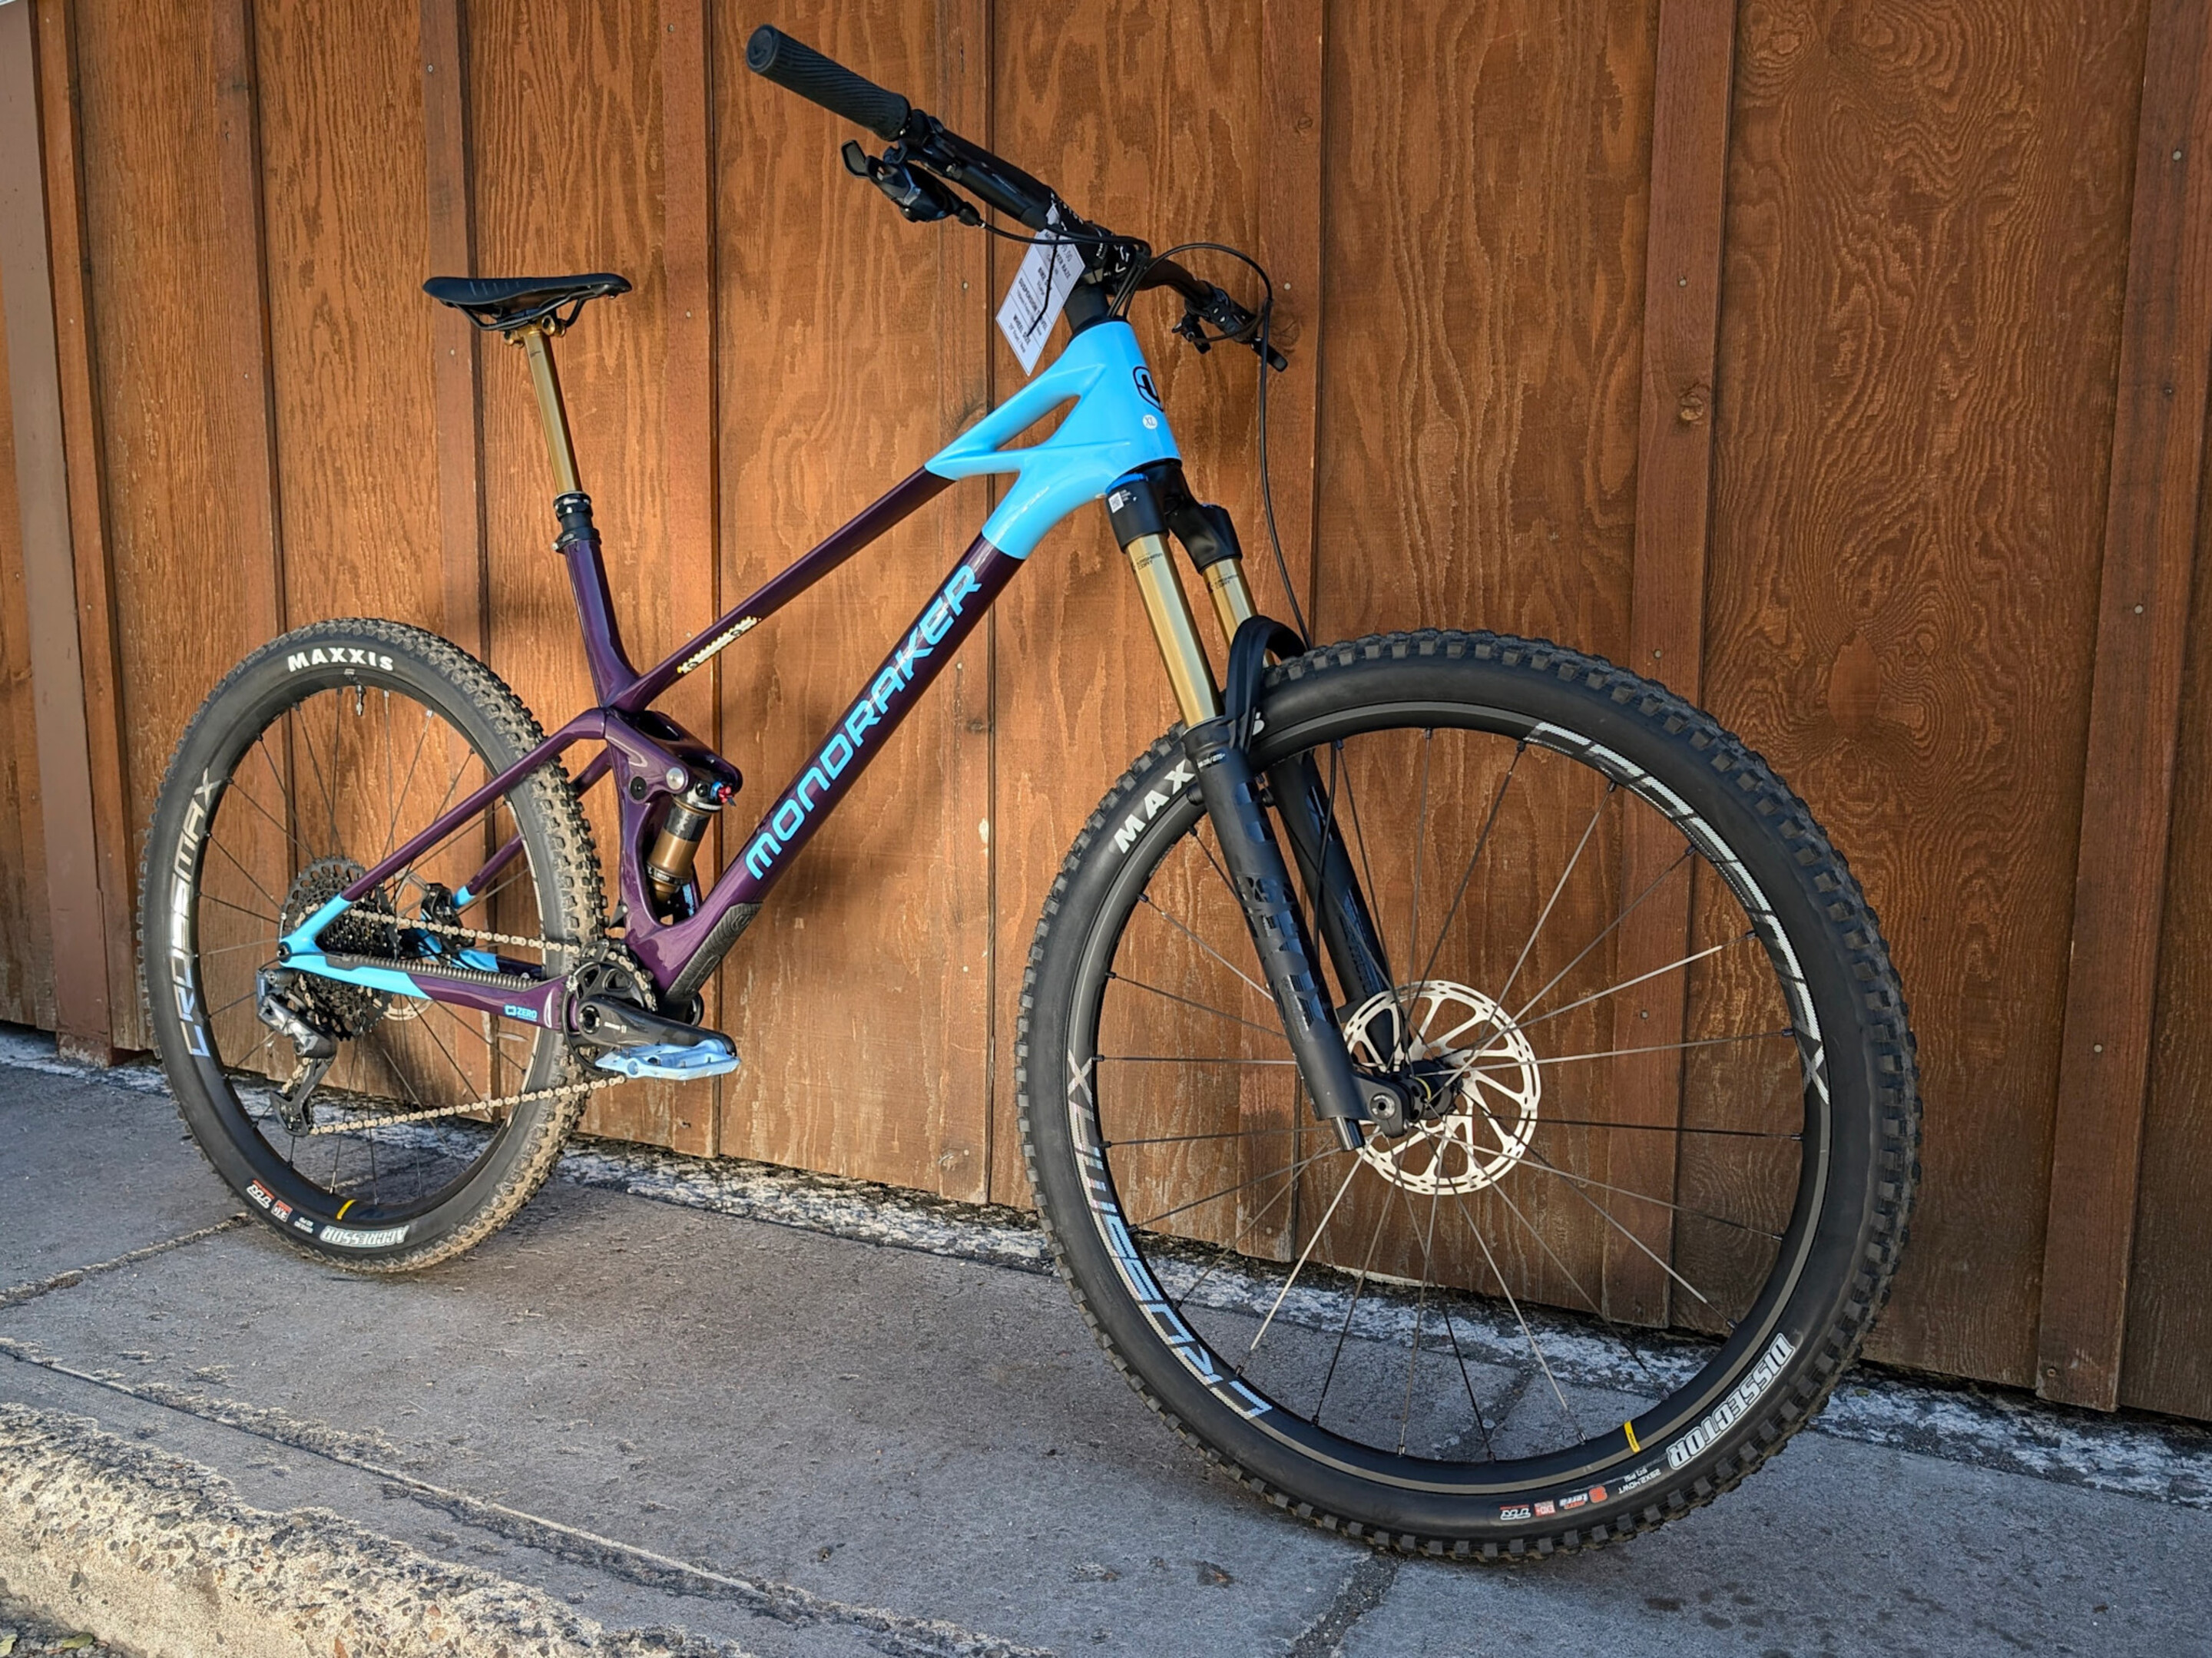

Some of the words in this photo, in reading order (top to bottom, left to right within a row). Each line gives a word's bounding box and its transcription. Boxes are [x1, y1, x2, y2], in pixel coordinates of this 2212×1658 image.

[287, 647, 394, 673] MAXXIS
[745, 564, 982, 881] MONDRAKER
[320, 1225, 410, 1248] AGGRESSOR
[1667, 1333, 1795, 1469] DISSECTOR
